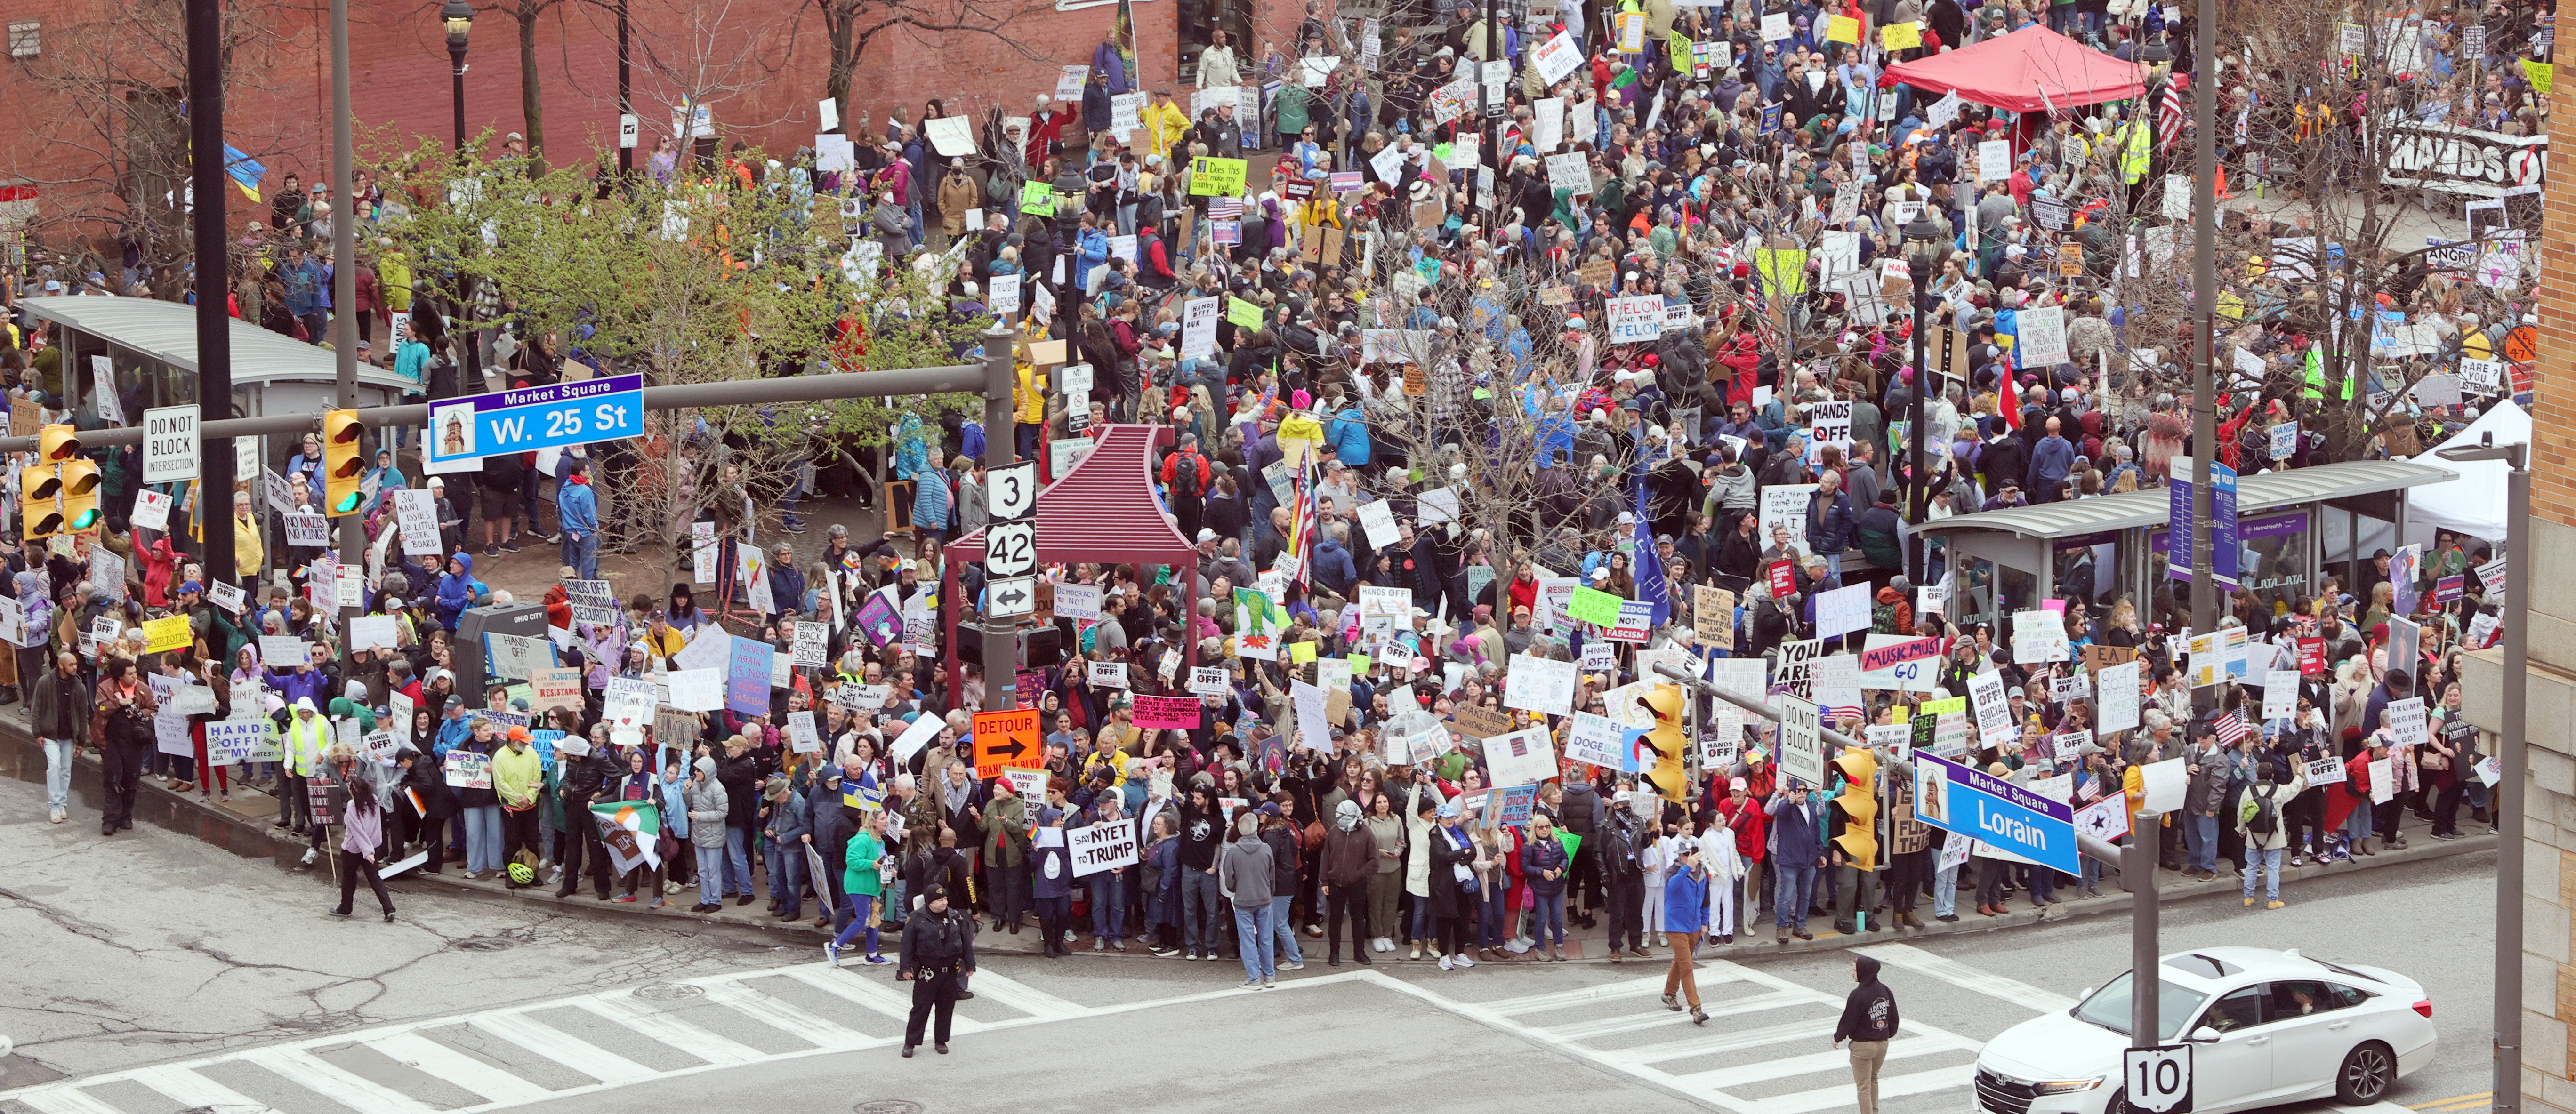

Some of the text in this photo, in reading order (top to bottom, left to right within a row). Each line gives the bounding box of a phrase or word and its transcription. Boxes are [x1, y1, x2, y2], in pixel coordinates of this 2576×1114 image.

[1537, 40, 1562, 61] ORANGE
[1551, 52, 1563, 64] LIES
[1549, 53, 1578, 78] MATTER!
[1484, 71, 1506, 79] LITTERING
[1210, 163, 1239, 175] Does this
[1218, 182, 1230, 190] look
[2033, 202, 2055, 211] SUPPORT
[2043, 220, 2059, 228] ALLIES
[993, 281, 1016, 292] TRUST
[991, 297, 1016, 307] SCIENCE
[1617, 323, 1660, 336] FELON
[2470, 363, 2488, 372] ARE
[1065, 377, 1090, 387] LITTERING
[2470, 372, 2486, 382] YOU
[505, 381, 611, 405] Market Square
[1814, 404, 1849, 419] HANDS
[151, 416, 192, 434] DO NOT
[491, 404, 627, 444] W. 25 St
[2273, 424, 2296, 435] HANDS
[1814, 426, 1848, 441] OFF
[2278, 434, 2293, 445] OFF
[153, 437, 191, 456] BLOCK
[2271, 446, 2295, 458] DEMOCRACY
[149, 459, 193, 473] INTERSECTION
[1003, 476, 1019, 506] 3
[2216, 492, 2222, 501] 51
[402, 493, 413, 503] SO
[399, 504, 419, 513] MANY
[407, 512, 430, 521] ISSUES
[285, 517, 323, 528] NO NAZIS
[403, 521, 435, 532] SO LITTLE
[2213, 520, 2224, 529] 51A
[2254, 522, 2282, 531] MetroHealth
[288, 529, 325, 539] NO KINGS
[990, 534, 1029, 564] 42
[561, 580, 607, 594] HANDS OFF
[1057, 586, 1095, 598] DEMOCRACY
[1362, 588, 1409, 598] HANDS OFF!
[570, 595, 614, 609] OUR SOCIAL
[1069, 598, 1085, 606] NOT
[1578, 600, 1604, 613] Have
[1586, 593, 1597, 601] THE
[1599, 596, 1620, 609] PEOPLE
[514, 612, 542, 623] OHIO CITY
[575, 608, 612, 623] SECURITY
[1056, 606, 1098, 618] DICTATORSHIP
[1586, 610, 1614, 625] POWER
[97, 617, 114, 625] HANDS
[152, 617, 182, 628] DISSENT
[97, 624, 113, 634] OFF!
[798, 623, 824, 632] BRING
[800, 633, 821, 641] BACK
[1606, 630, 1644, 639] FASCISM
[794, 641, 827, 650] COMMON
[1586, 646, 1610, 654] HANDS
[796, 651, 825, 661] SENSE
[1865, 638, 1940, 668] MUSK MUST
[1589, 657, 1610, 666] OFF
[1895, 663, 1917, 679] GO
[1976, 681, 1999, 694] HANDS
[1978, 689, 2002, 706] OFF!
[1980, 703, 2007, 721] SOCIAL
[2391, 702, 2421, 713] TRUMP
[1786, 705, 1815, 730] DO NOT
[1981, 715, 2008, 730] SECURITY
[2392, 713, 2423, 724] REGIME
[211, 724, 271, 736] HANDS
[979, 719, 1033, 735] DETOUR
[2395, 725, 2423, 734] MUST
[222, 737, 258, 747] OFF!
[263, 737, 276, 746] JOBS
[1787, 730, 1814, 754] BLOCK
[2402, 734, 2416, 743] GO!
[231, 748, 250, 757] MY
[1785, 752, 1816, 772] INTERSECTION
[2310, 759, 2335, 767] HANDS
[2312, 765, 2337, 775] OFF!
[1969, 772, 2048, 812] Market Square
[1506, 795, 1529, 806] DICK
[1501, 813, 1527, 822] BALLS
[1979, 799, 2046, 850] Lorain
[1075, 825, 1128, 844] SAY NYET
[1087, 842, 1133, 864] TRUMP
[2139, 1060, 2180, 1096] 10
